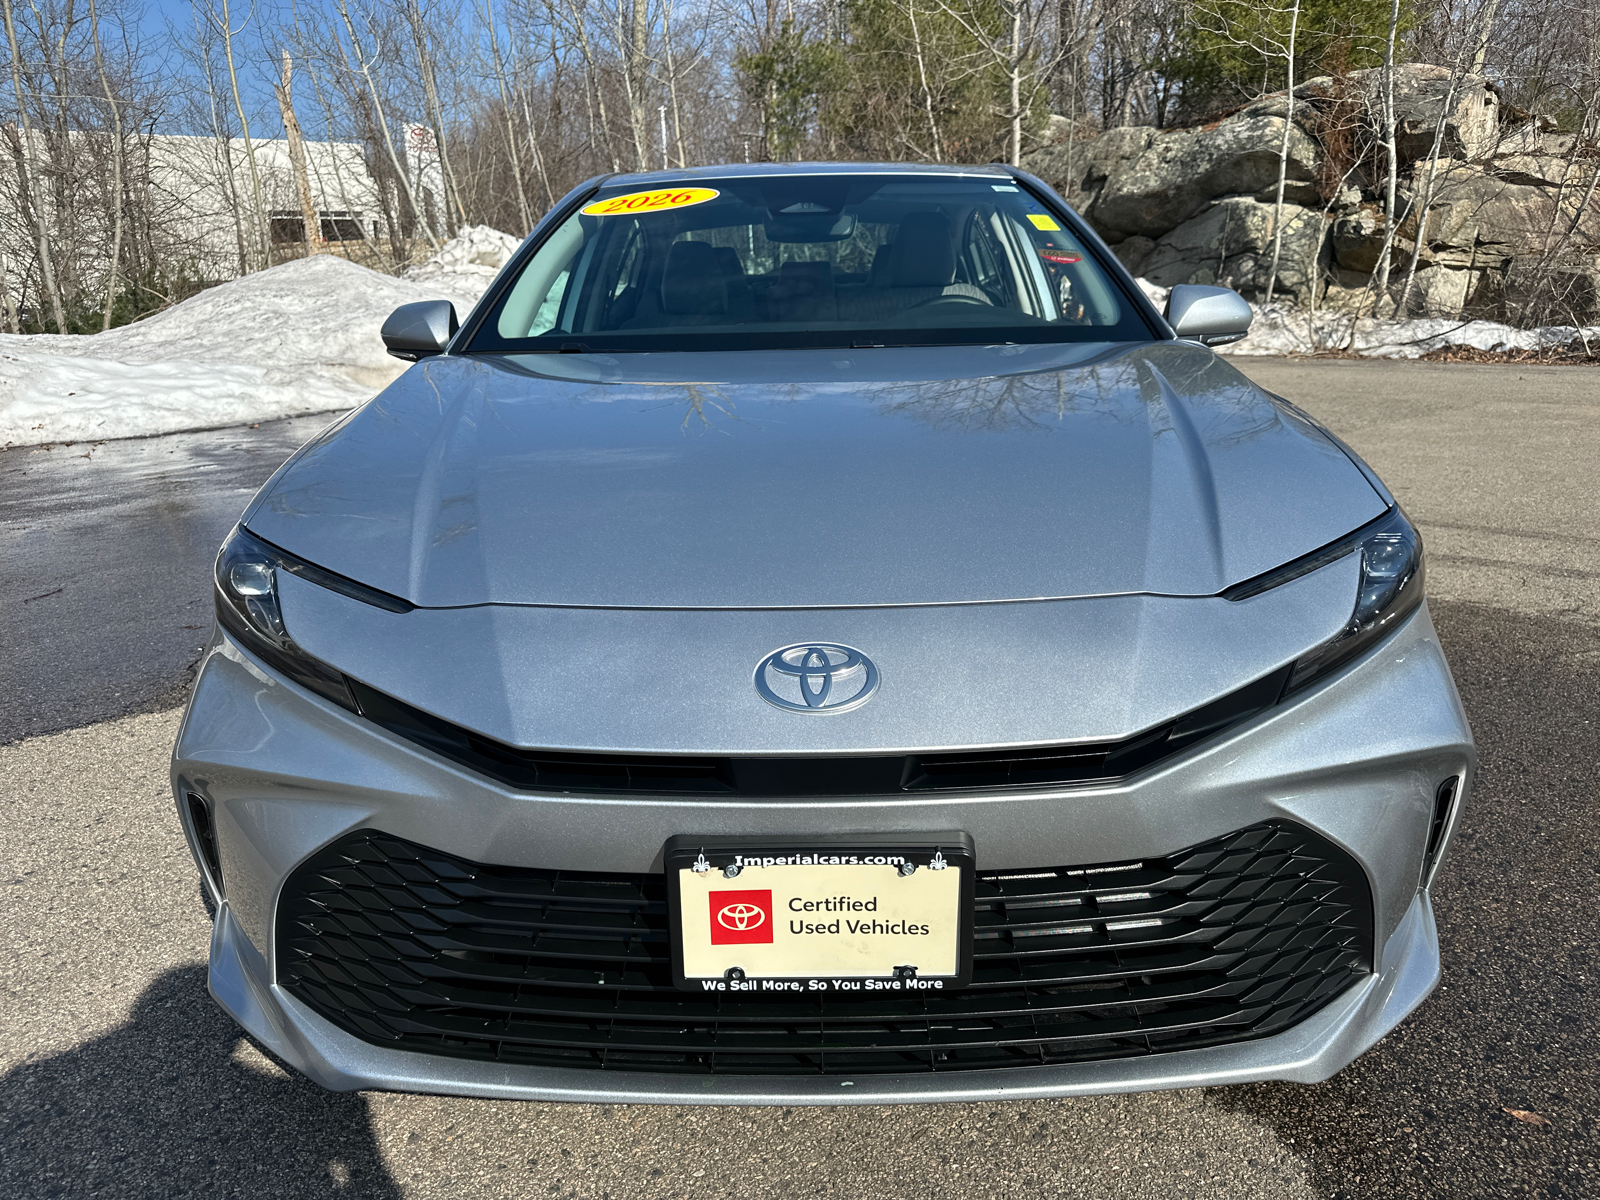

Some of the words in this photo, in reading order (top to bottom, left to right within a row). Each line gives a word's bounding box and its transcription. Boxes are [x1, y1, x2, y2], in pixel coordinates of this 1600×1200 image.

[602, 190, 697, 213] 2026
[735, 853, 905, 868] Imperialcars.com
[788, 896, 877, 912] Certified
[789, 919, 840, 934] Used
[845, 919, 930, 935] Vehicles
[701, 980, 726, 991] We
[730, 979, 757, 991] Sell
[762, 980, 804, 992] More,
[808, 979, 828, 991] So
[832, 979, 861, 990] You
[864, 979, 902, 990] Save
[905, 978, 943, 989] More
